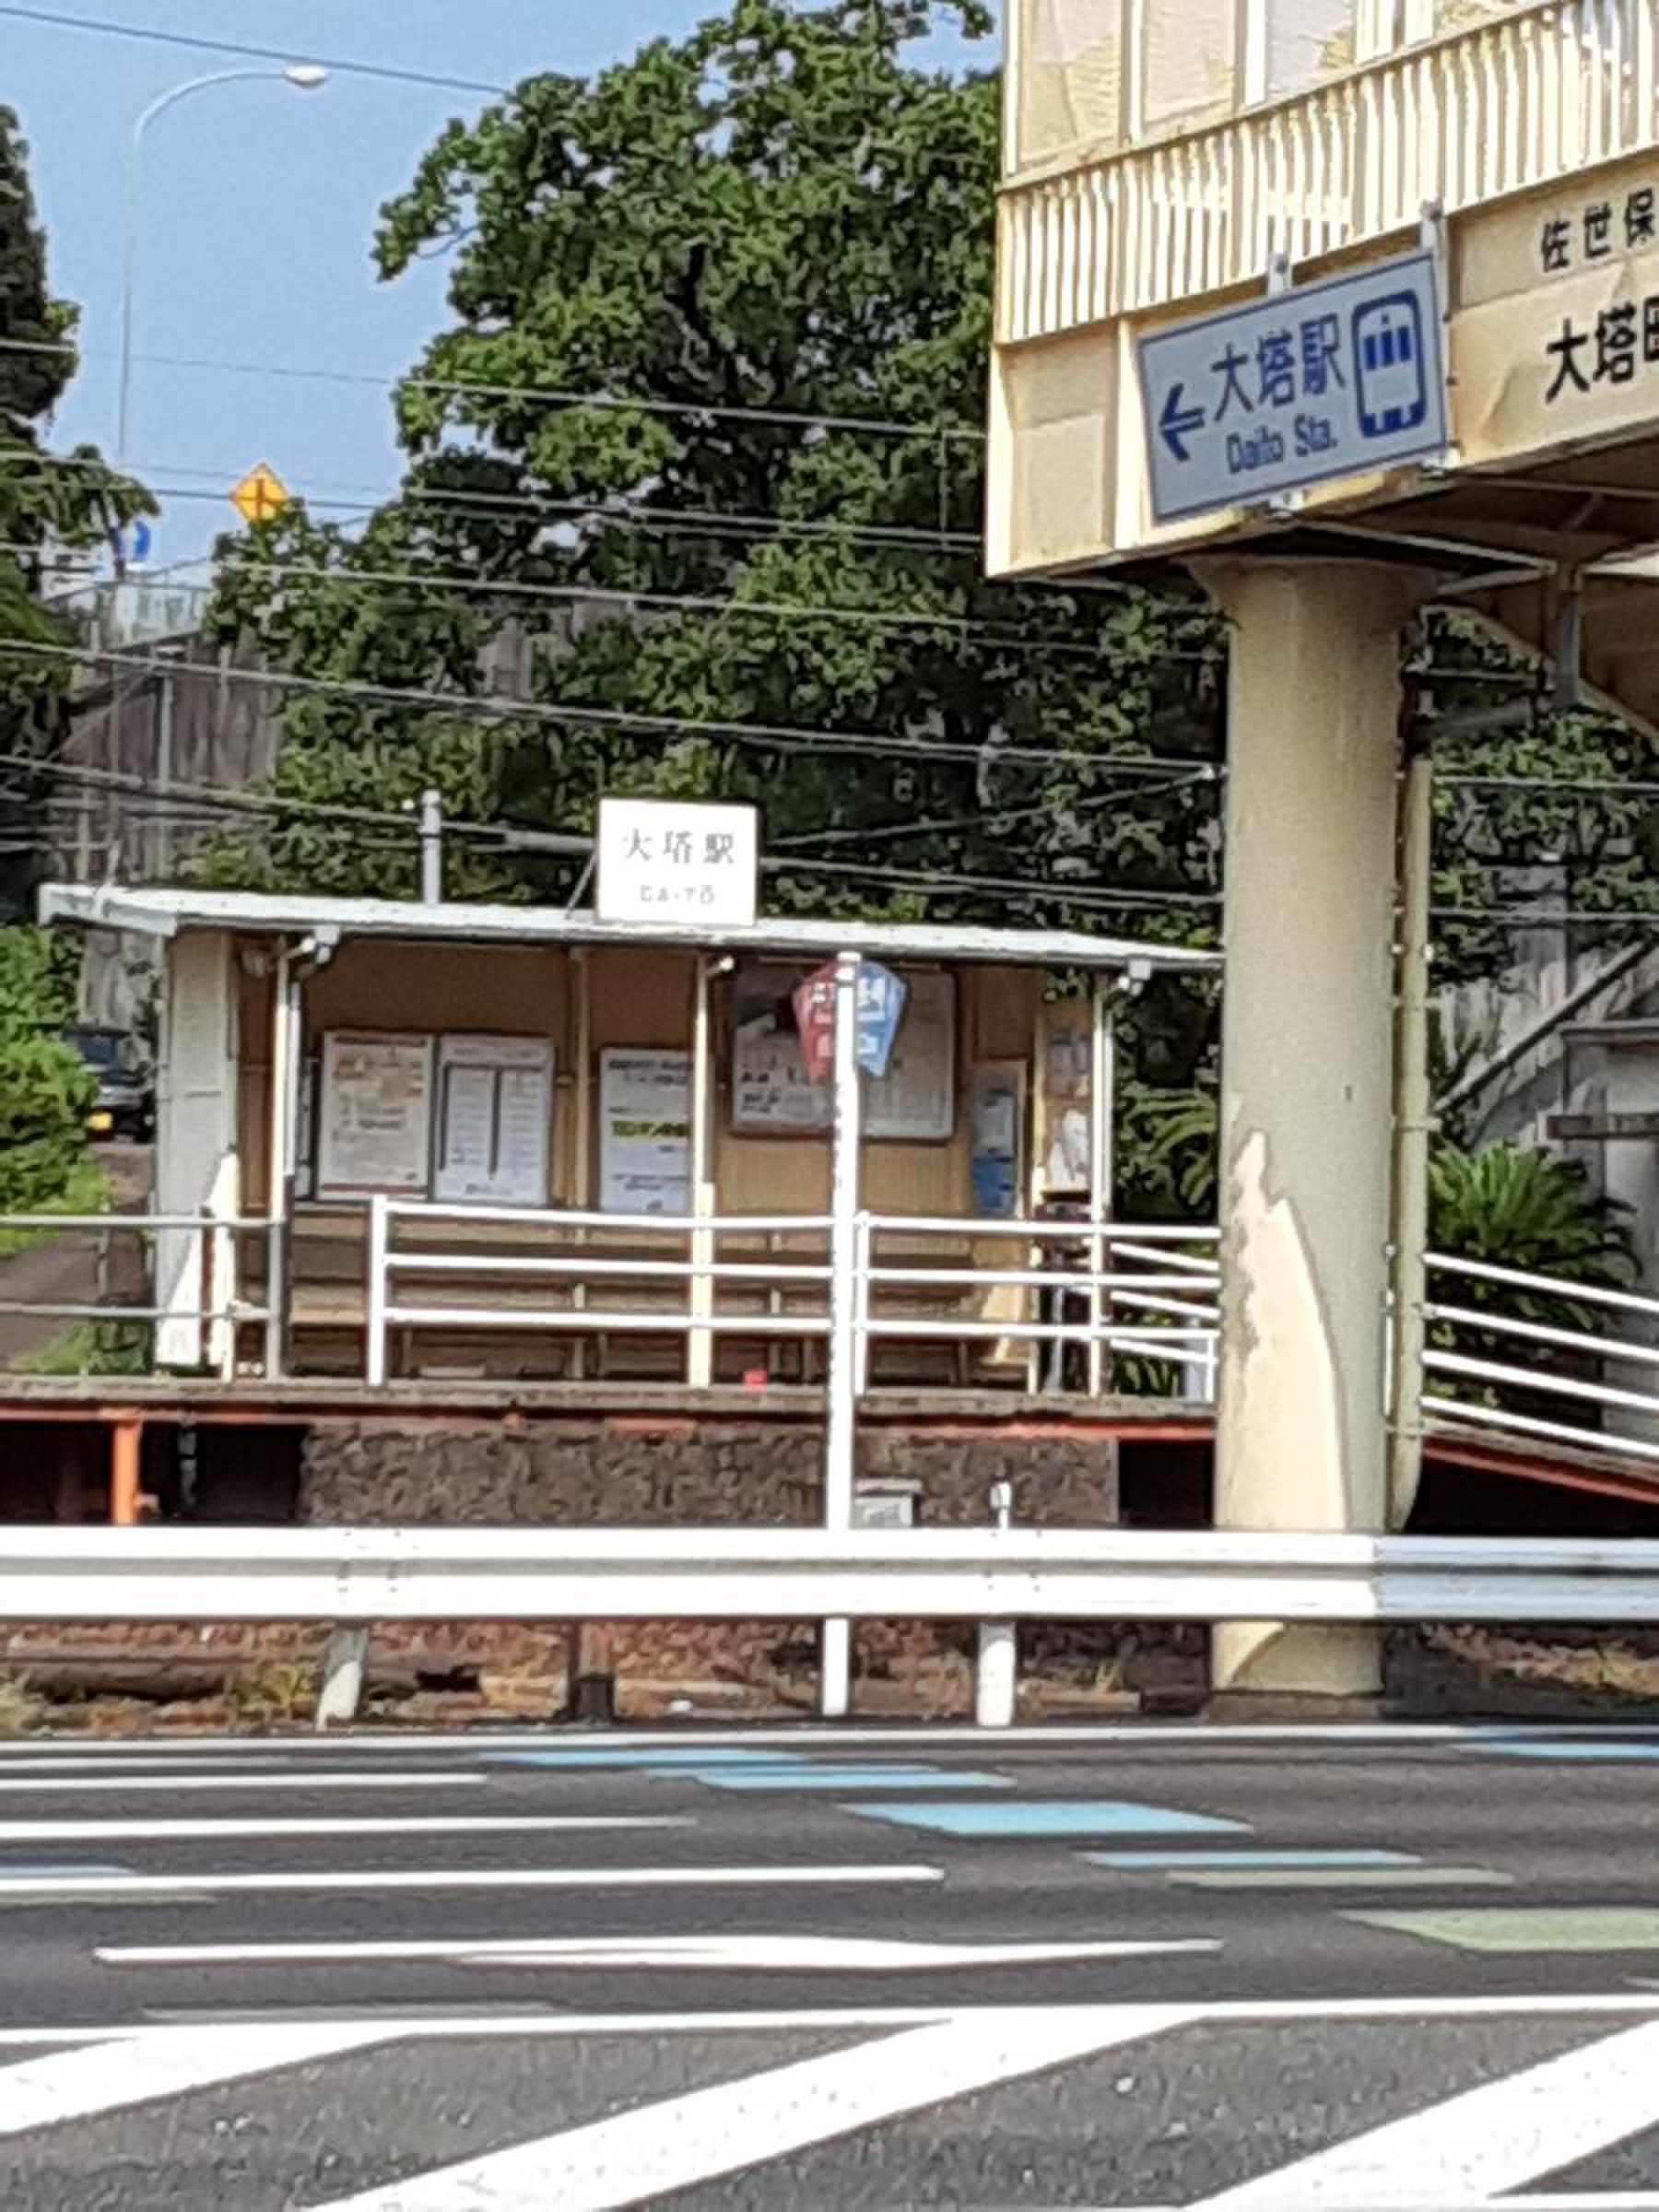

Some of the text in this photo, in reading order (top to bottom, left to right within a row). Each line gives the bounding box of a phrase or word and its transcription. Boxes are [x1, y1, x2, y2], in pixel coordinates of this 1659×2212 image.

[1540, 187, 1655, 273] 佐世保
[1210, 312, 1346, 421] 大塔駅
[622, 828, 735, 865] 大塔駅
